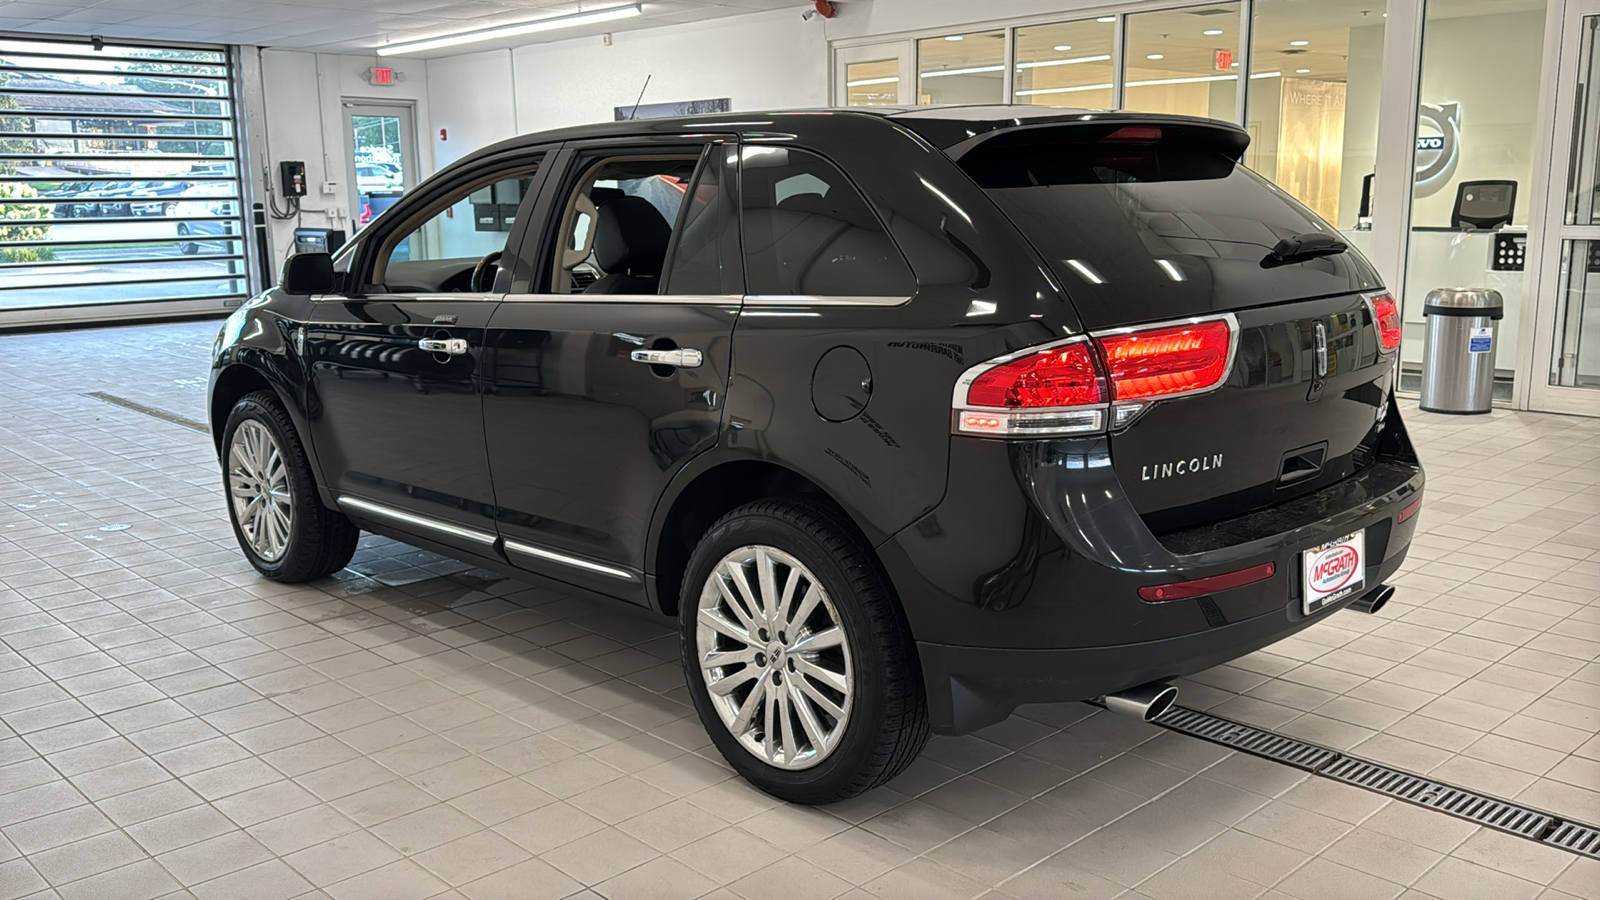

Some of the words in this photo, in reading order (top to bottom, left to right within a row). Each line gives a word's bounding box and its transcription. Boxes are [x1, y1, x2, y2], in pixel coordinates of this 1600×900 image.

[1219, 52, 1231, 69] EXIT
[374, 68, 392, 83] EXIT
[1289, 91, 1323, 105] WHERE
[1417, 138, 1442, 148] VO
[1141, 453, 1223, 481] LINCOLN
